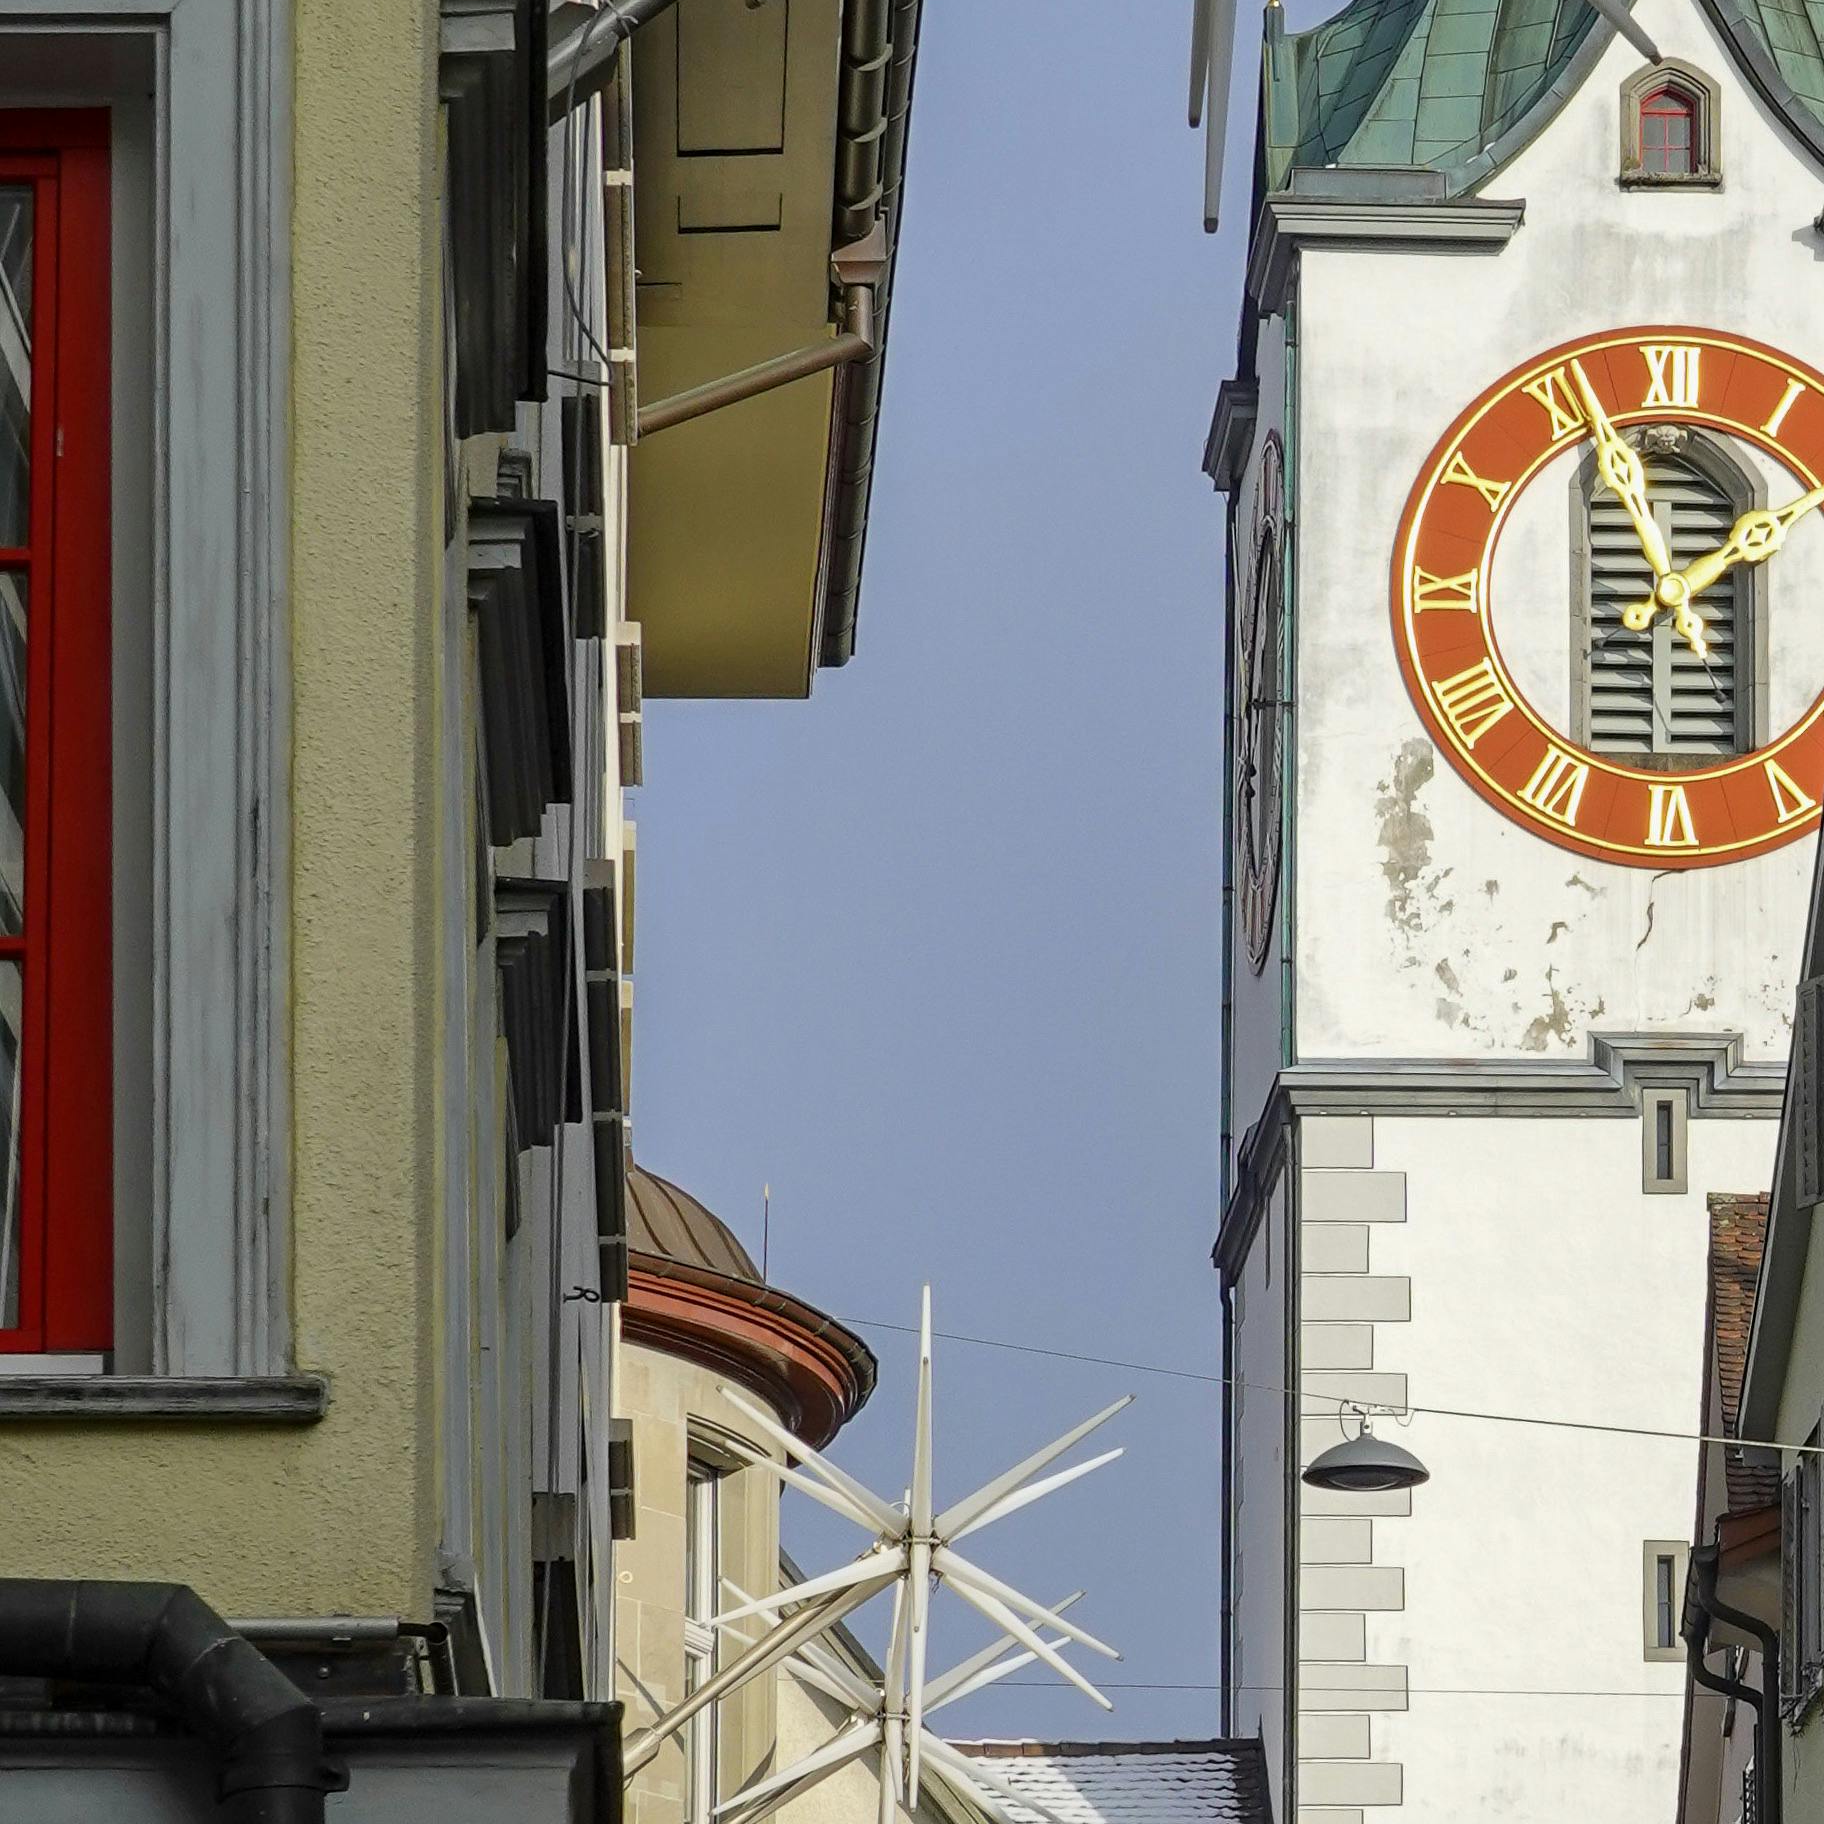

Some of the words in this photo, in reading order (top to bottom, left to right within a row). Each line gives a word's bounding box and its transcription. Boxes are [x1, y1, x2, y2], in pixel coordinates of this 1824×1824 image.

[1521, 365, 1587, 442] XI
[1638, 345, 1701, 408] XII
[1759, 377, 1806, 438] I
[1440, 450, 1512, 512] X
[1413, 565, 1478, 614] IX
[1431, 656, 1515, 750] VIII
[1516, 742, 1590, 827] VII
[1643, 783, 1700, 846] VI
[1763, 758, 1817, 824] V
